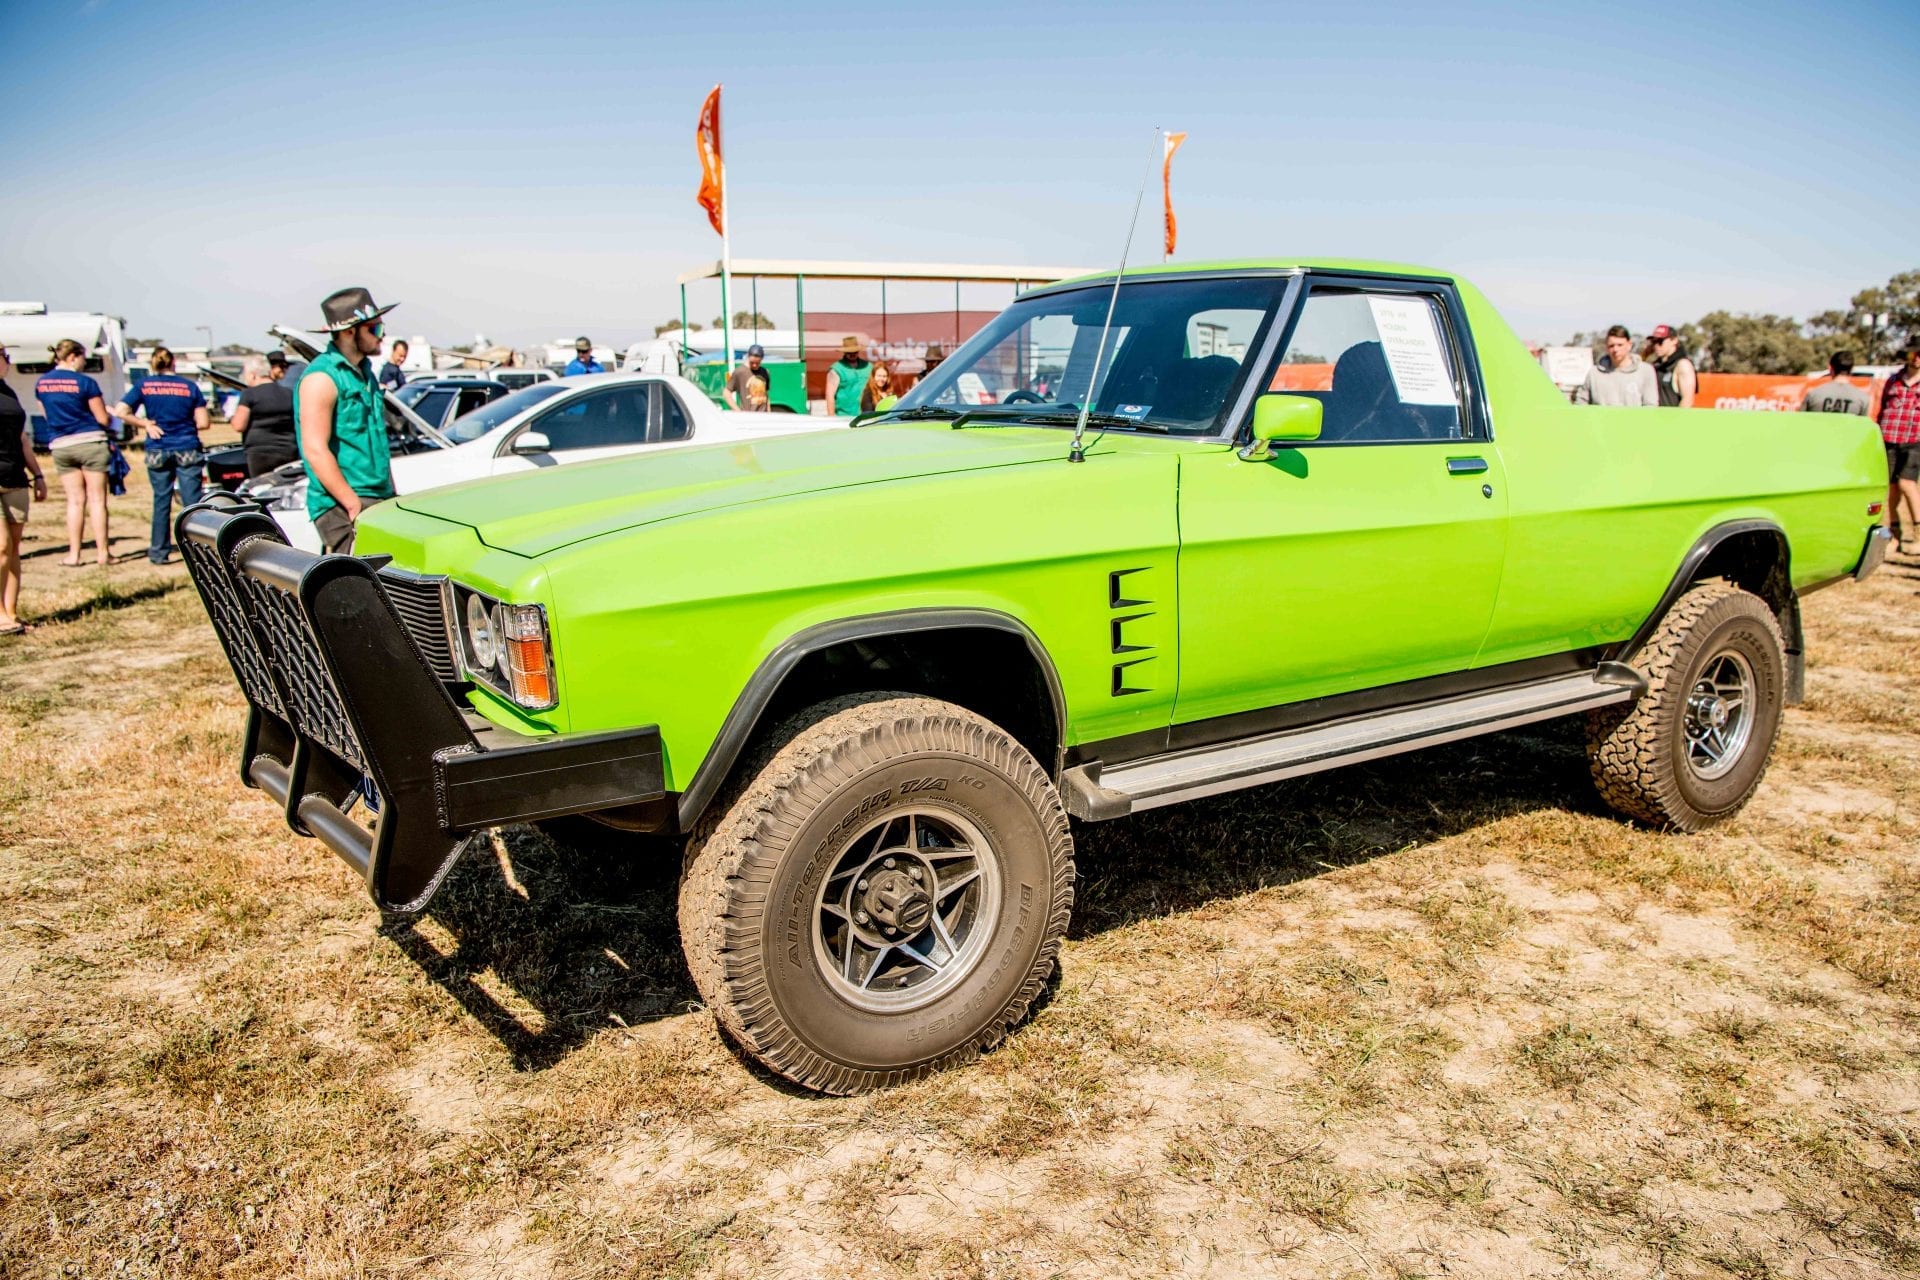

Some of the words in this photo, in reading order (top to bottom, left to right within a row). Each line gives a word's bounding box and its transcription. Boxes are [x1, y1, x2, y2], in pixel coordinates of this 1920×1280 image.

[38, 384, 80, 394] VOLUNTEER
[141, 386, 191, 398] VOLUNTEER
[1822, 397, 1853, 413] CAT
[900, 777, 949, 795] T/A
[906, 882, 1034, 1043] BFGoodrich
